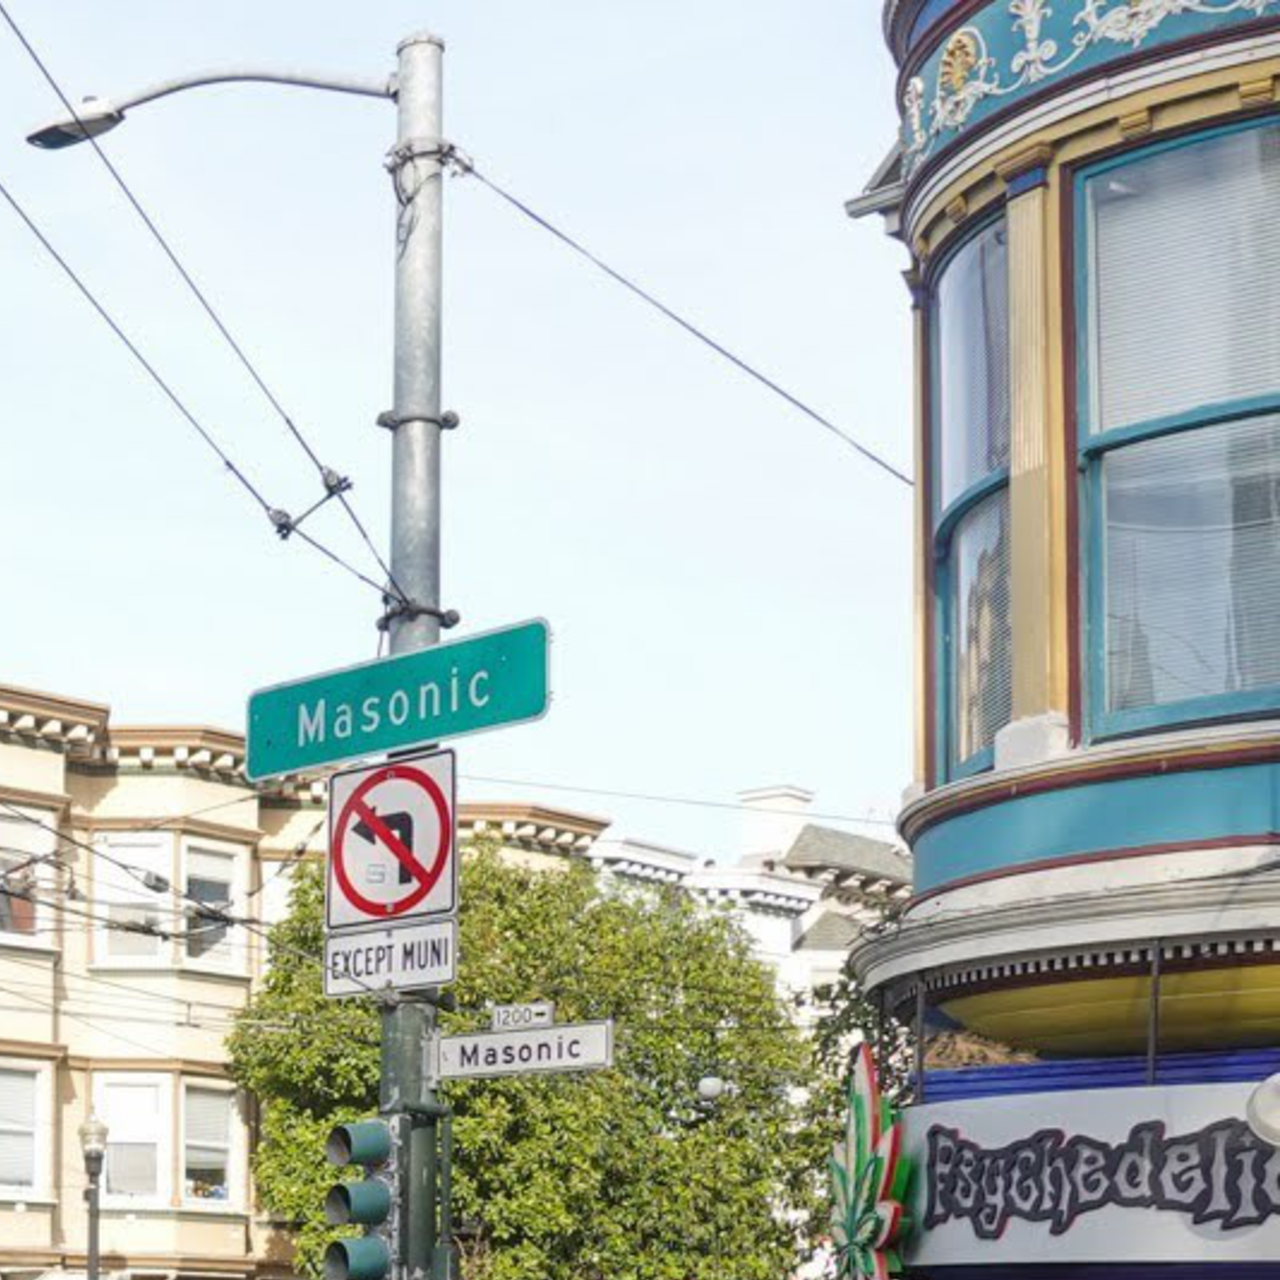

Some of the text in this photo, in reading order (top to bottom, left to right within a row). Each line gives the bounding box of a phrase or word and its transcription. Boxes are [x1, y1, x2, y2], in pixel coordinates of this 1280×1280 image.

[297, 667, 491, 748] Masonic
[331, 938, 449, 981] EXCEPT MUNI
[495, 1006, 533, 1026] 1200
[459, 1035, 582, 1068] Masonic
